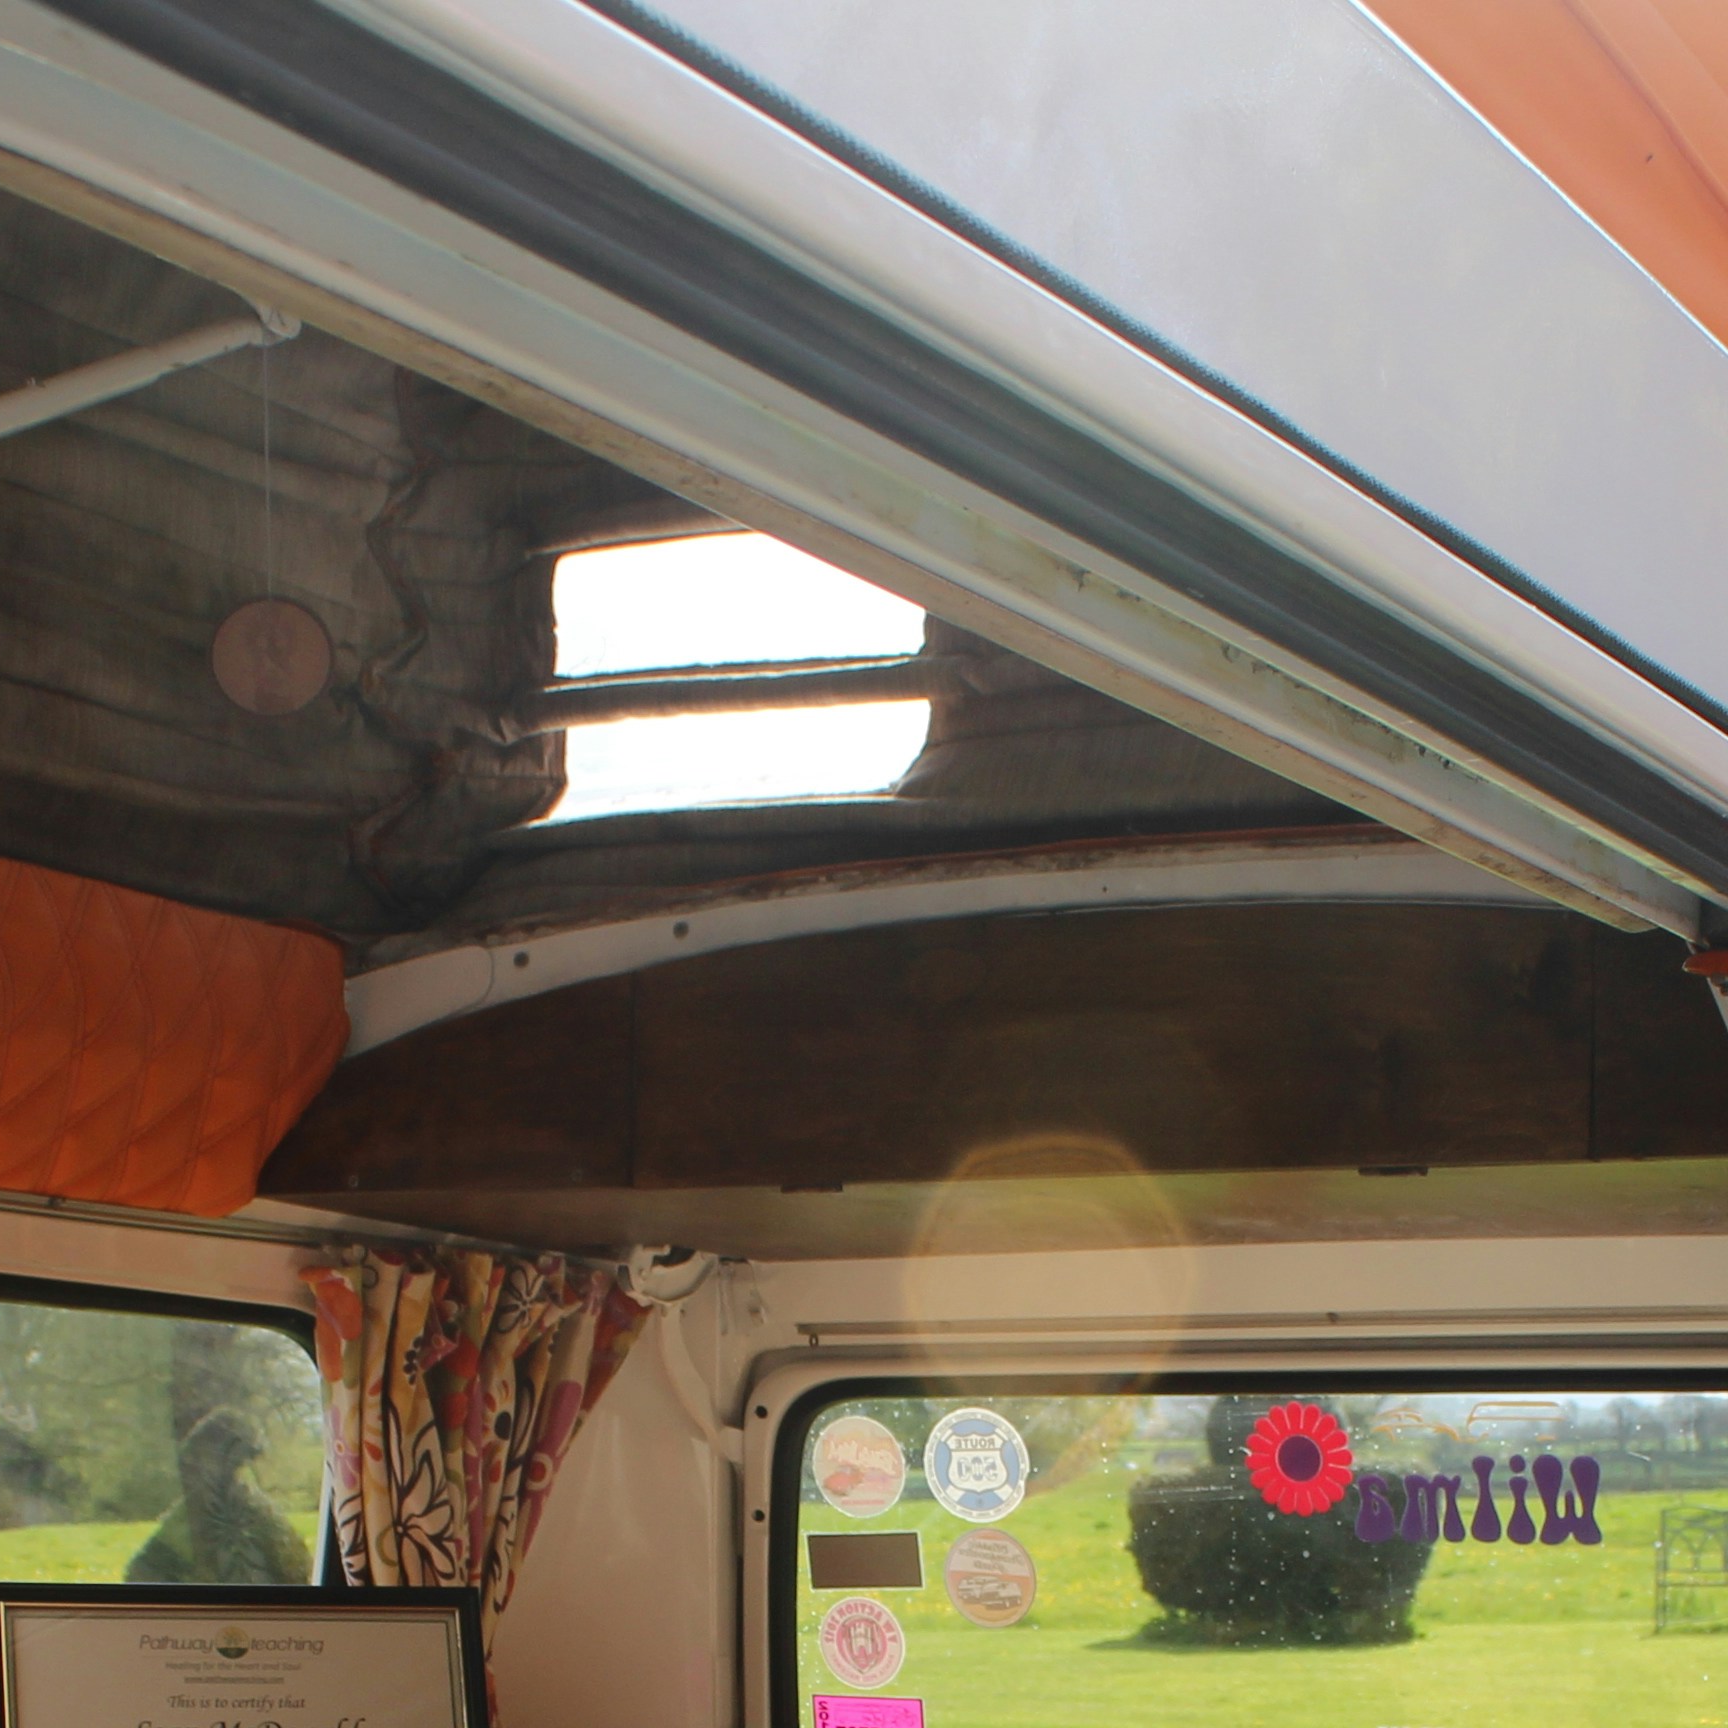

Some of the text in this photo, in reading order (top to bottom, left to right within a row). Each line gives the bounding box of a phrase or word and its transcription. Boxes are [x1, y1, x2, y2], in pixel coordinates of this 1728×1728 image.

[139, 1634, 324, 1656] Pathway teaching
[167, 1694, 305, 1713] This is to certify that
